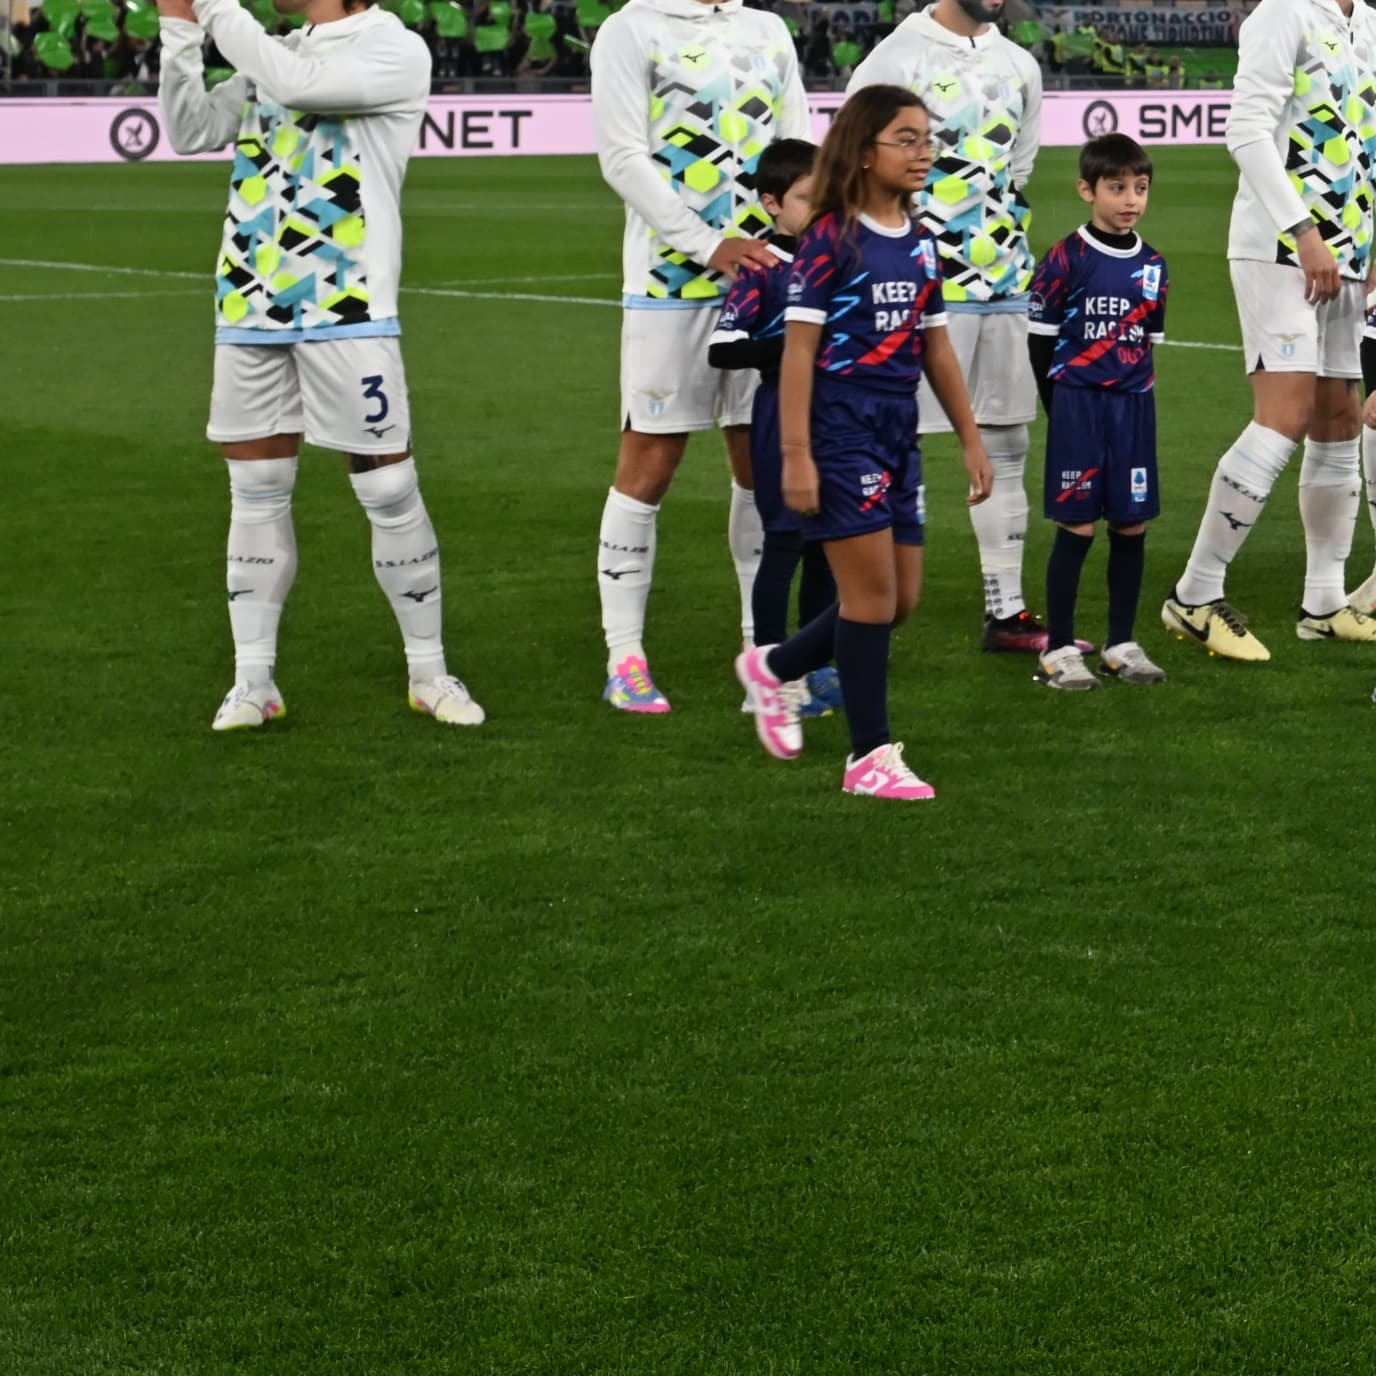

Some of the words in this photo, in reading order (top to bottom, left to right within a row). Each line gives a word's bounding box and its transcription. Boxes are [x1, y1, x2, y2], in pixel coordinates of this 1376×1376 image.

[871, 281, 916, 305] KEEP
[1085, 296, 1131, 317] KEEP
[361, 375, 388, 423] 3
